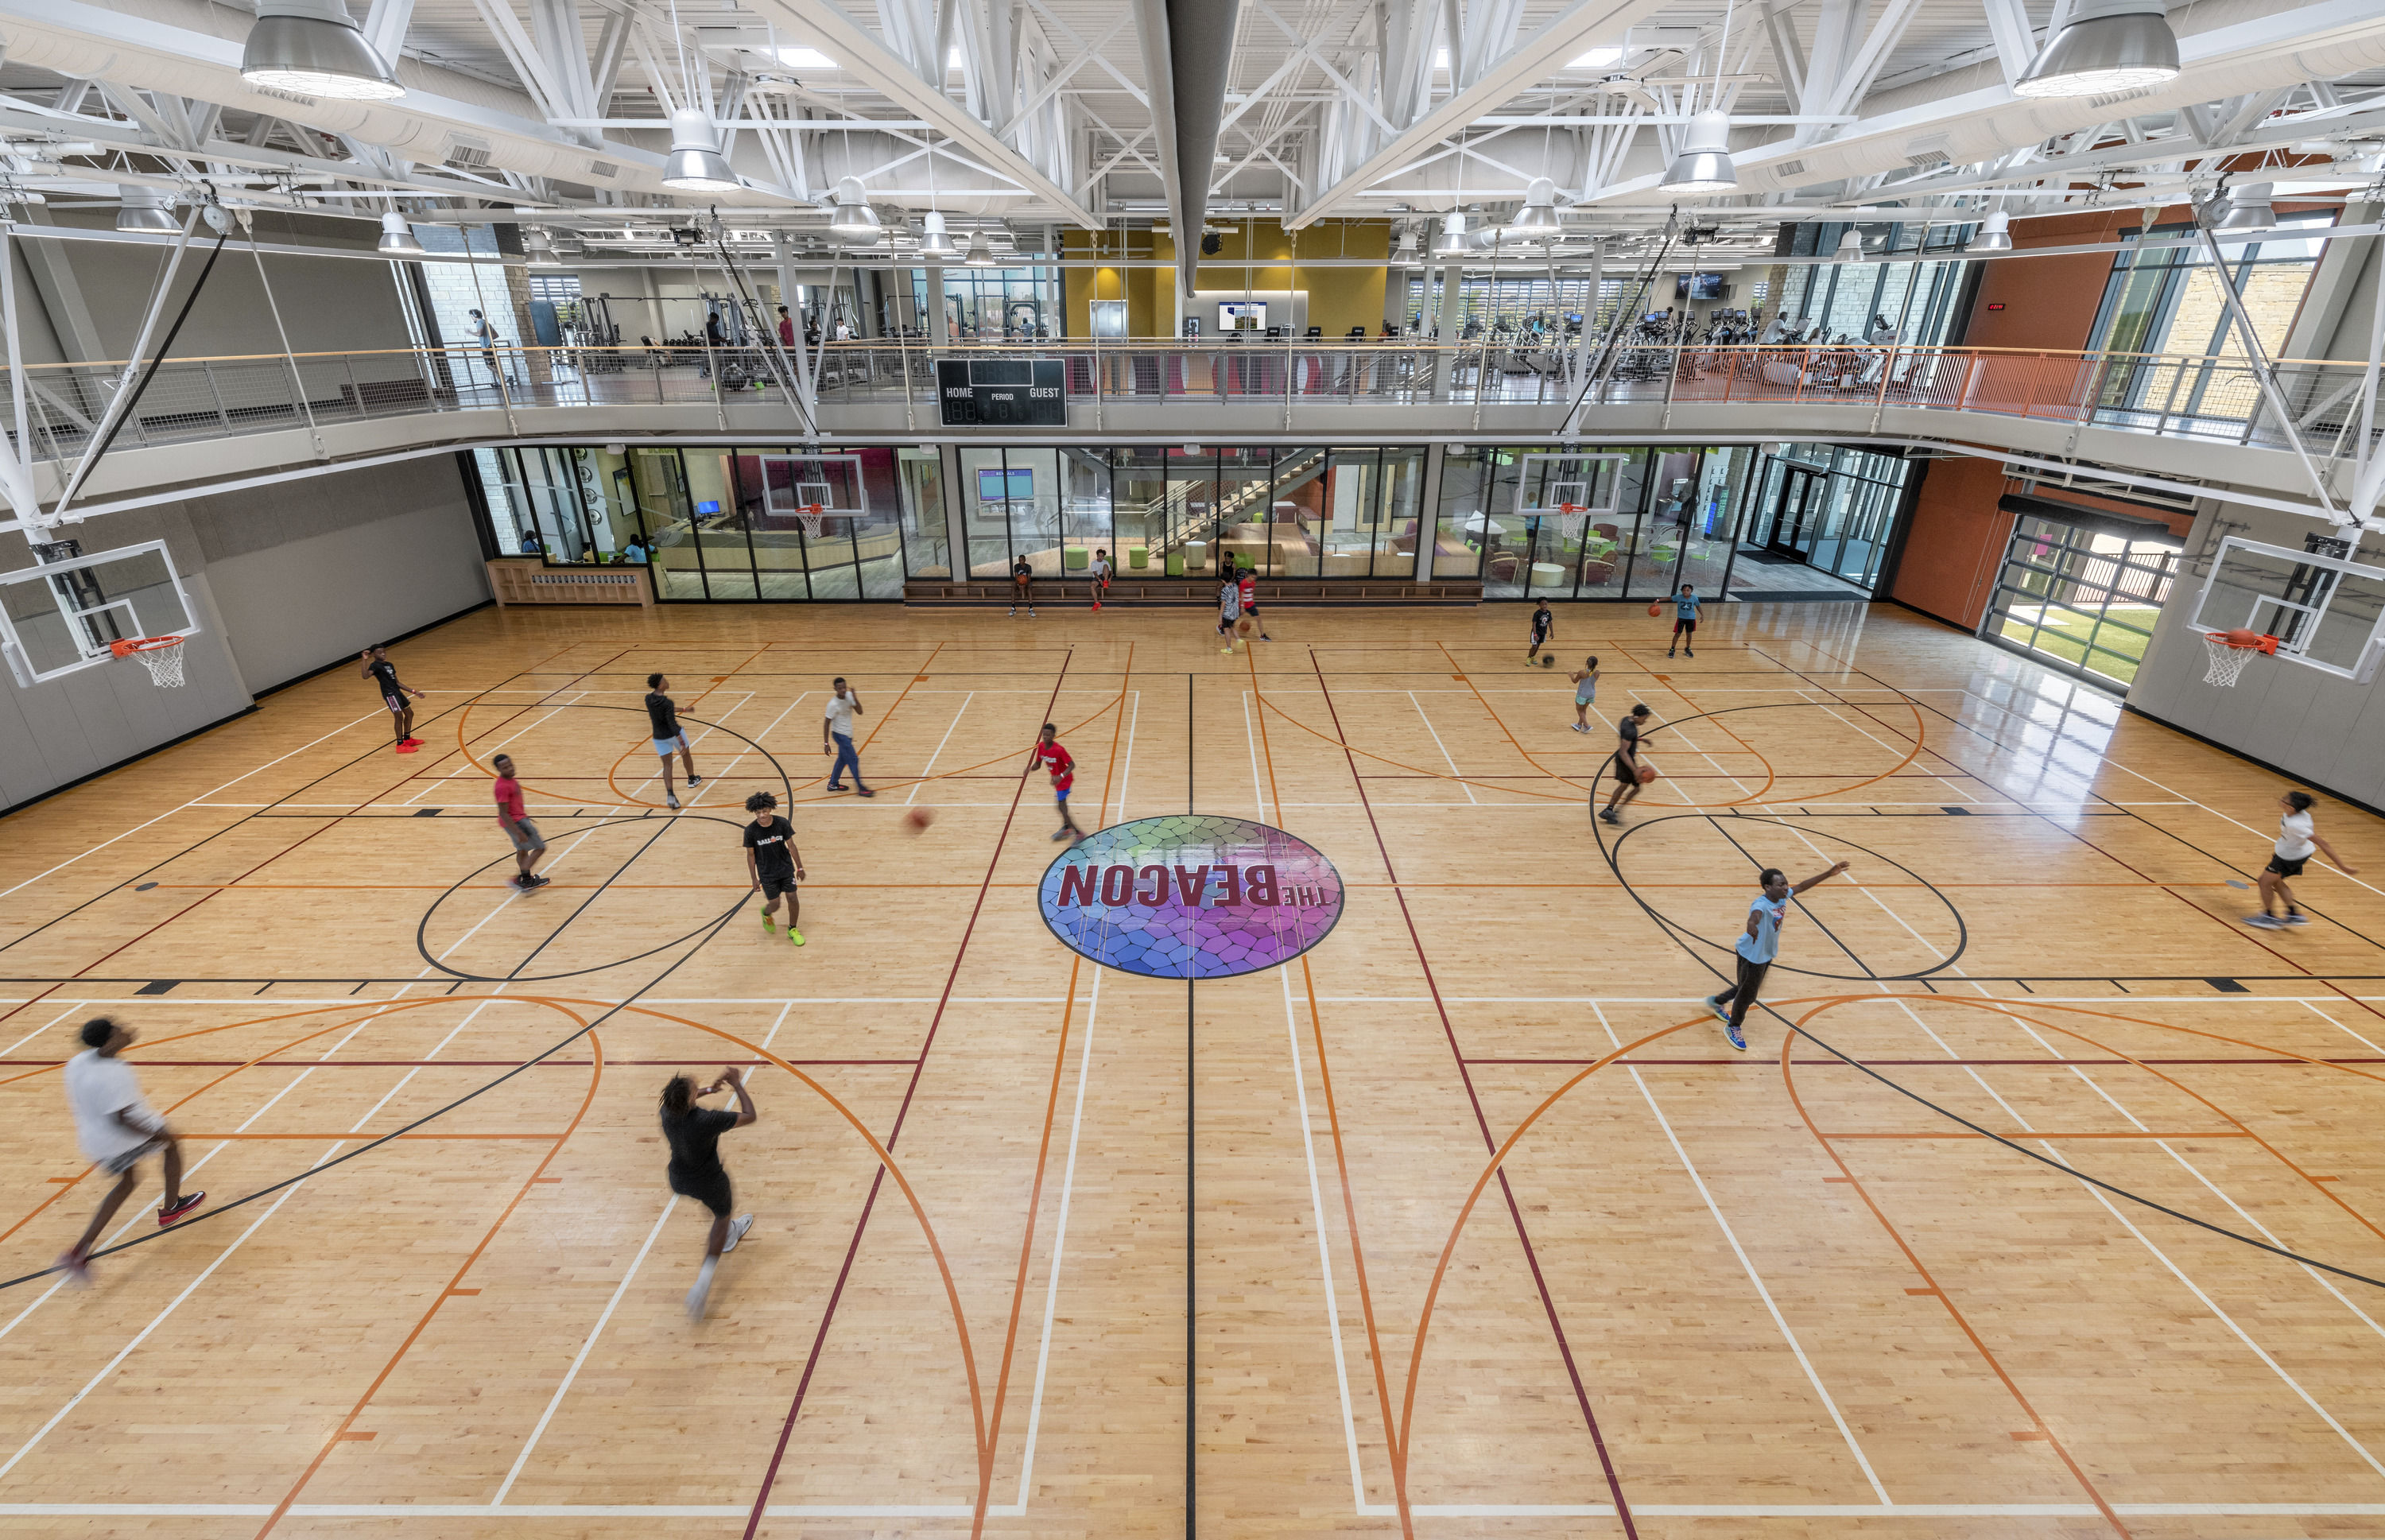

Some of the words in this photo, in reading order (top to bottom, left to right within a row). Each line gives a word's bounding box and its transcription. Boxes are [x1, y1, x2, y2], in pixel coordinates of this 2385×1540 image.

[946, 387, 973, 398] HOME
[1030, 387, 1060, 398] GUEST
[1717, 499, 1727, 518] BEACON
[1680, 601, 1692, 611] 23
[1057, 863, 1281, 907] BEACON
[1280, 886, 1332, 907] THE
